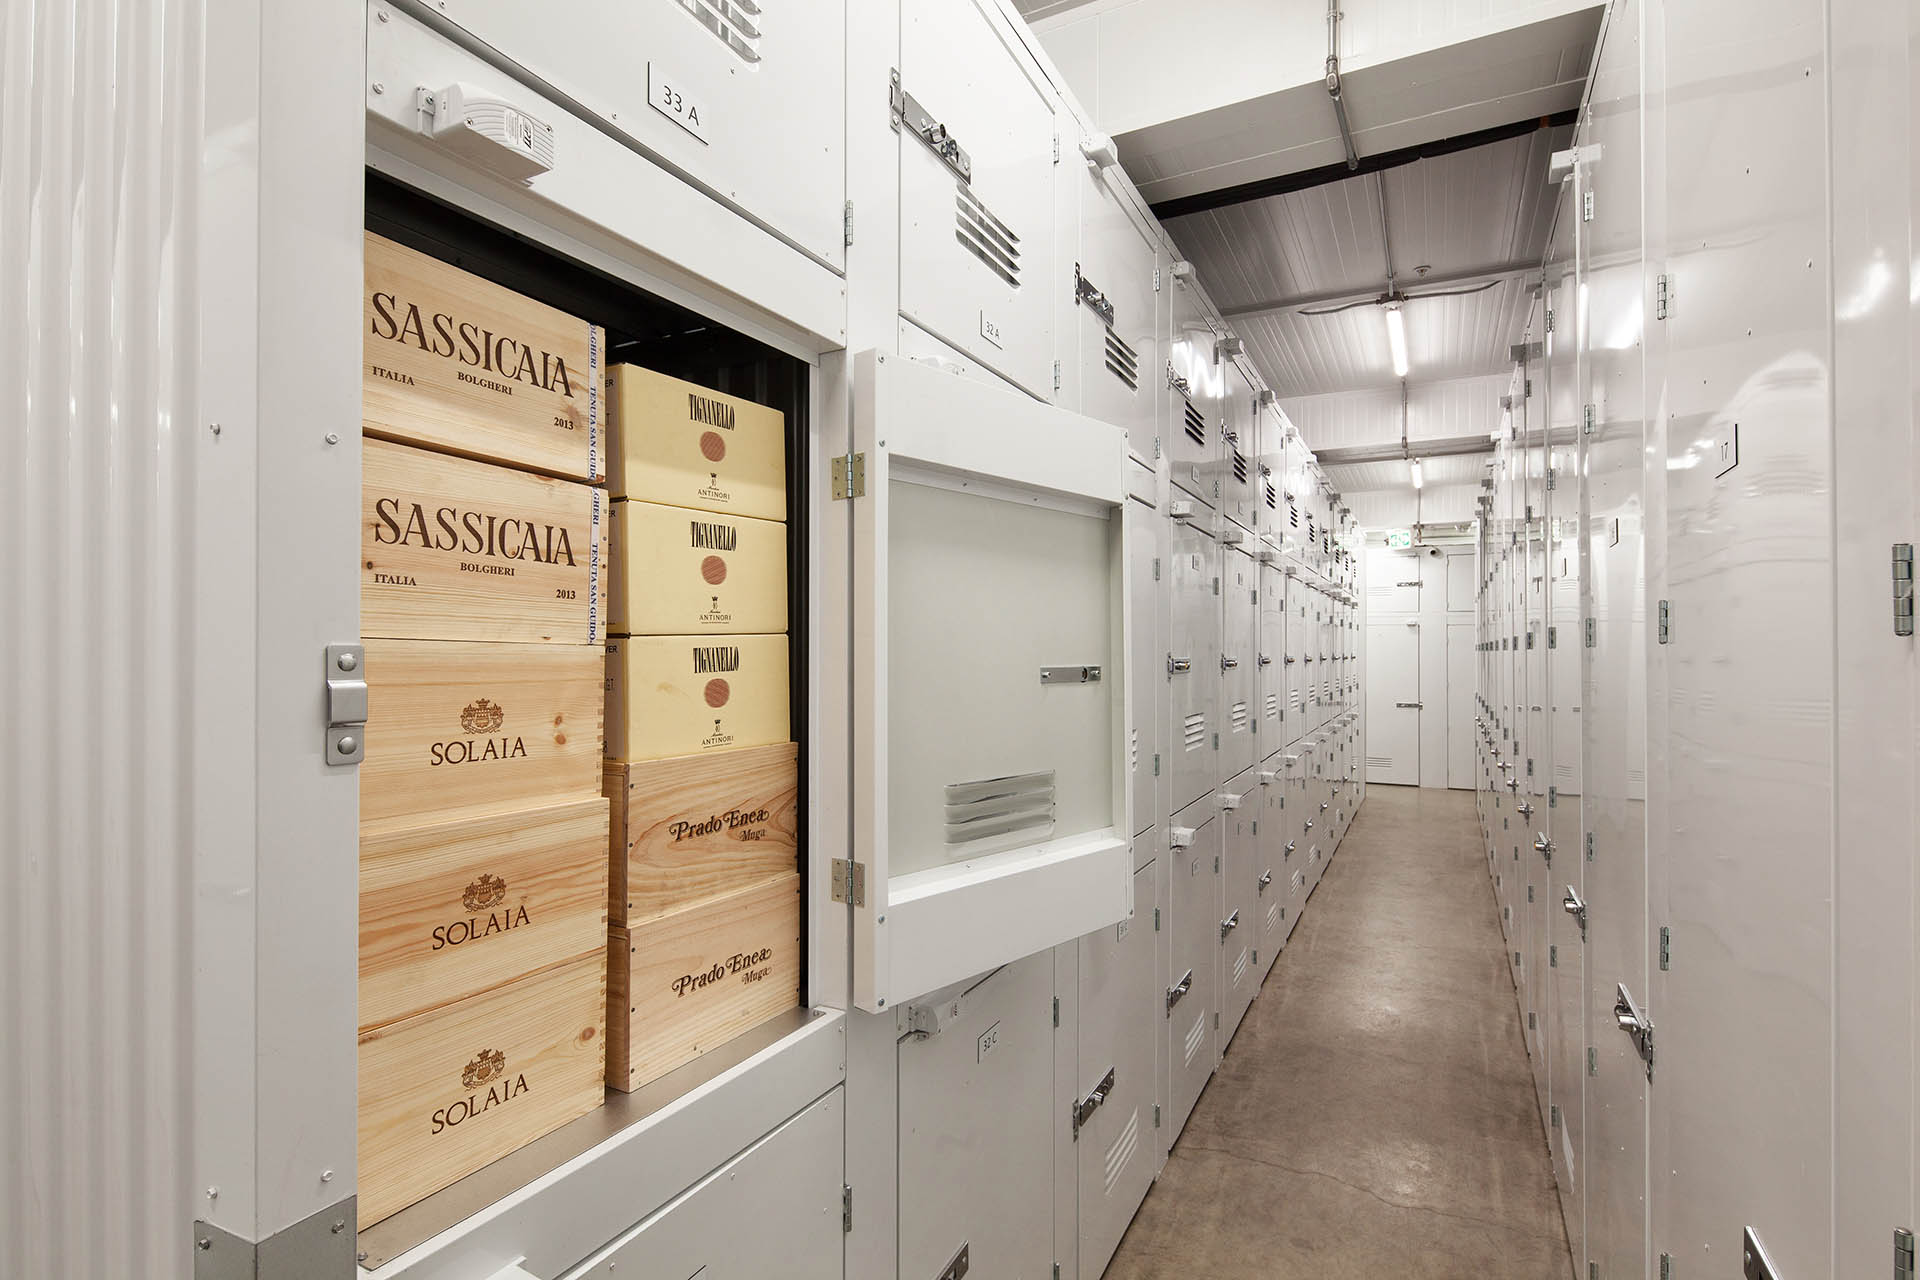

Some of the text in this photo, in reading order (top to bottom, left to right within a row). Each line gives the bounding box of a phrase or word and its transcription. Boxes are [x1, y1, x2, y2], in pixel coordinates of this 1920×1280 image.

[663, 85, 700, 127] 33 A
[986, 321, 1000, 339] 32 A
[371, 292, 575, 398] SASSICAIA
[372, 365, 415, 386] ITALIA
[457, 371, 513, 396] BOLGHERI
[553, 416, 574, 431] 2013
[688, 393, 735, 432] TIGNANELLO
[698, 488, 730, 500] ANTINORI
[374, 498, 577, 567] SASSICAIA
[690, 520, 737, 552] TIGNANELLO
[460, 562, 515, 577] BOLGHERI
[590, 543, 599, 583] TENUTA
[374, 573, 417, 586] ITALIA
[556, 588, 576, 600] 2013
[590, 584, 598, 604] SAN
[693, 646, 740, 674] TIGNANELLO
[430, 736, 528, 766] SOLAIA
[701, 735, 734, 745] ANTINORI
[668, 807, 770, 843] Prado Enea
[739, 827, 769, 842] Muga
[432, 905, 531, 951] SOLAIA
[671, 947, 772, 998] Prado Enea
[741, 966, 772, 986] Muga
[983, 1037, 991, 1051] 32
[431, 1073, 530, 1135] SOLAIA
